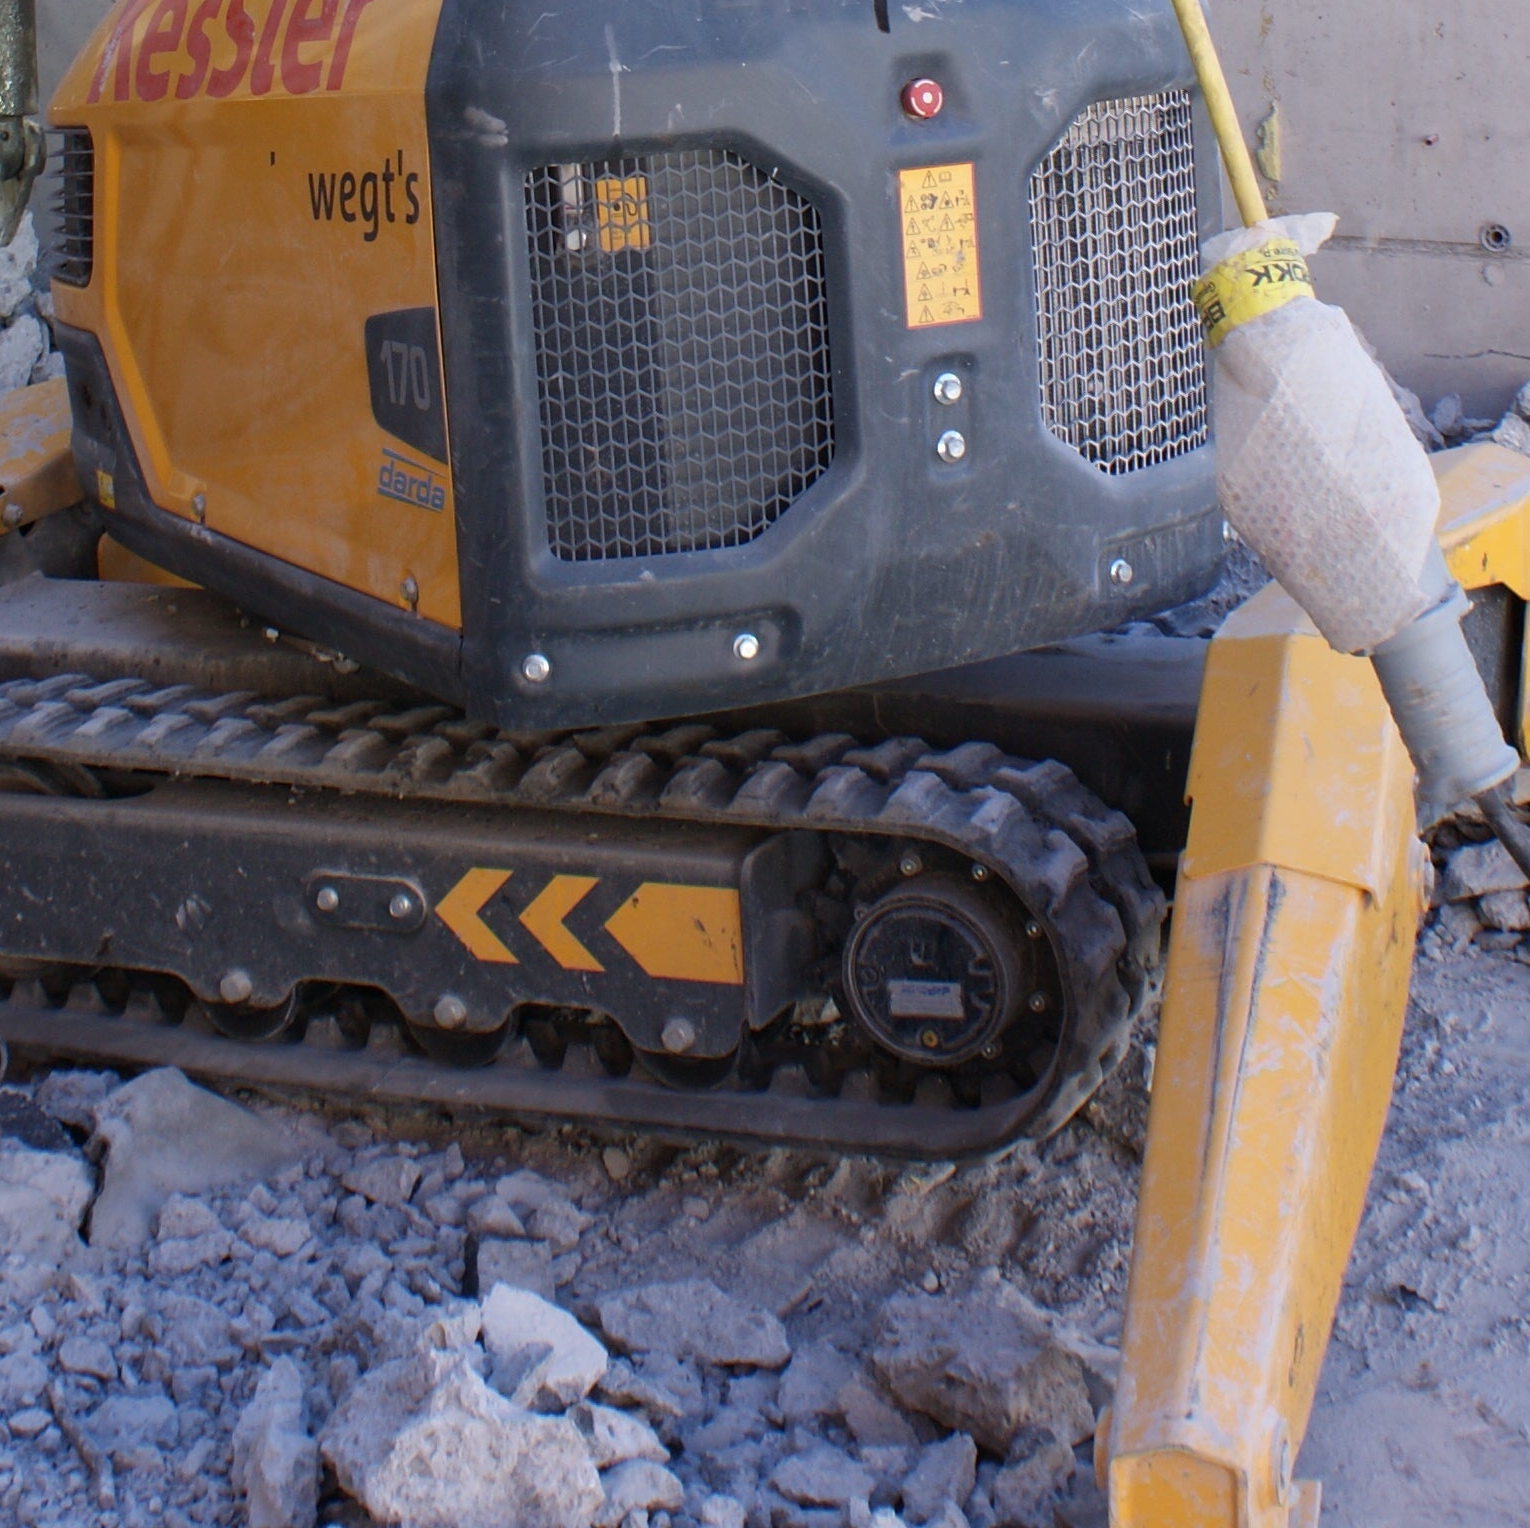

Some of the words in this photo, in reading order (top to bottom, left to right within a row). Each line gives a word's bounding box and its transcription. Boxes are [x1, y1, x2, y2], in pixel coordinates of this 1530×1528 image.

[307, 149, 420, 242] wegt's
[380, 340, 431, 412] 170
[378, 459, 446, 511] darda
